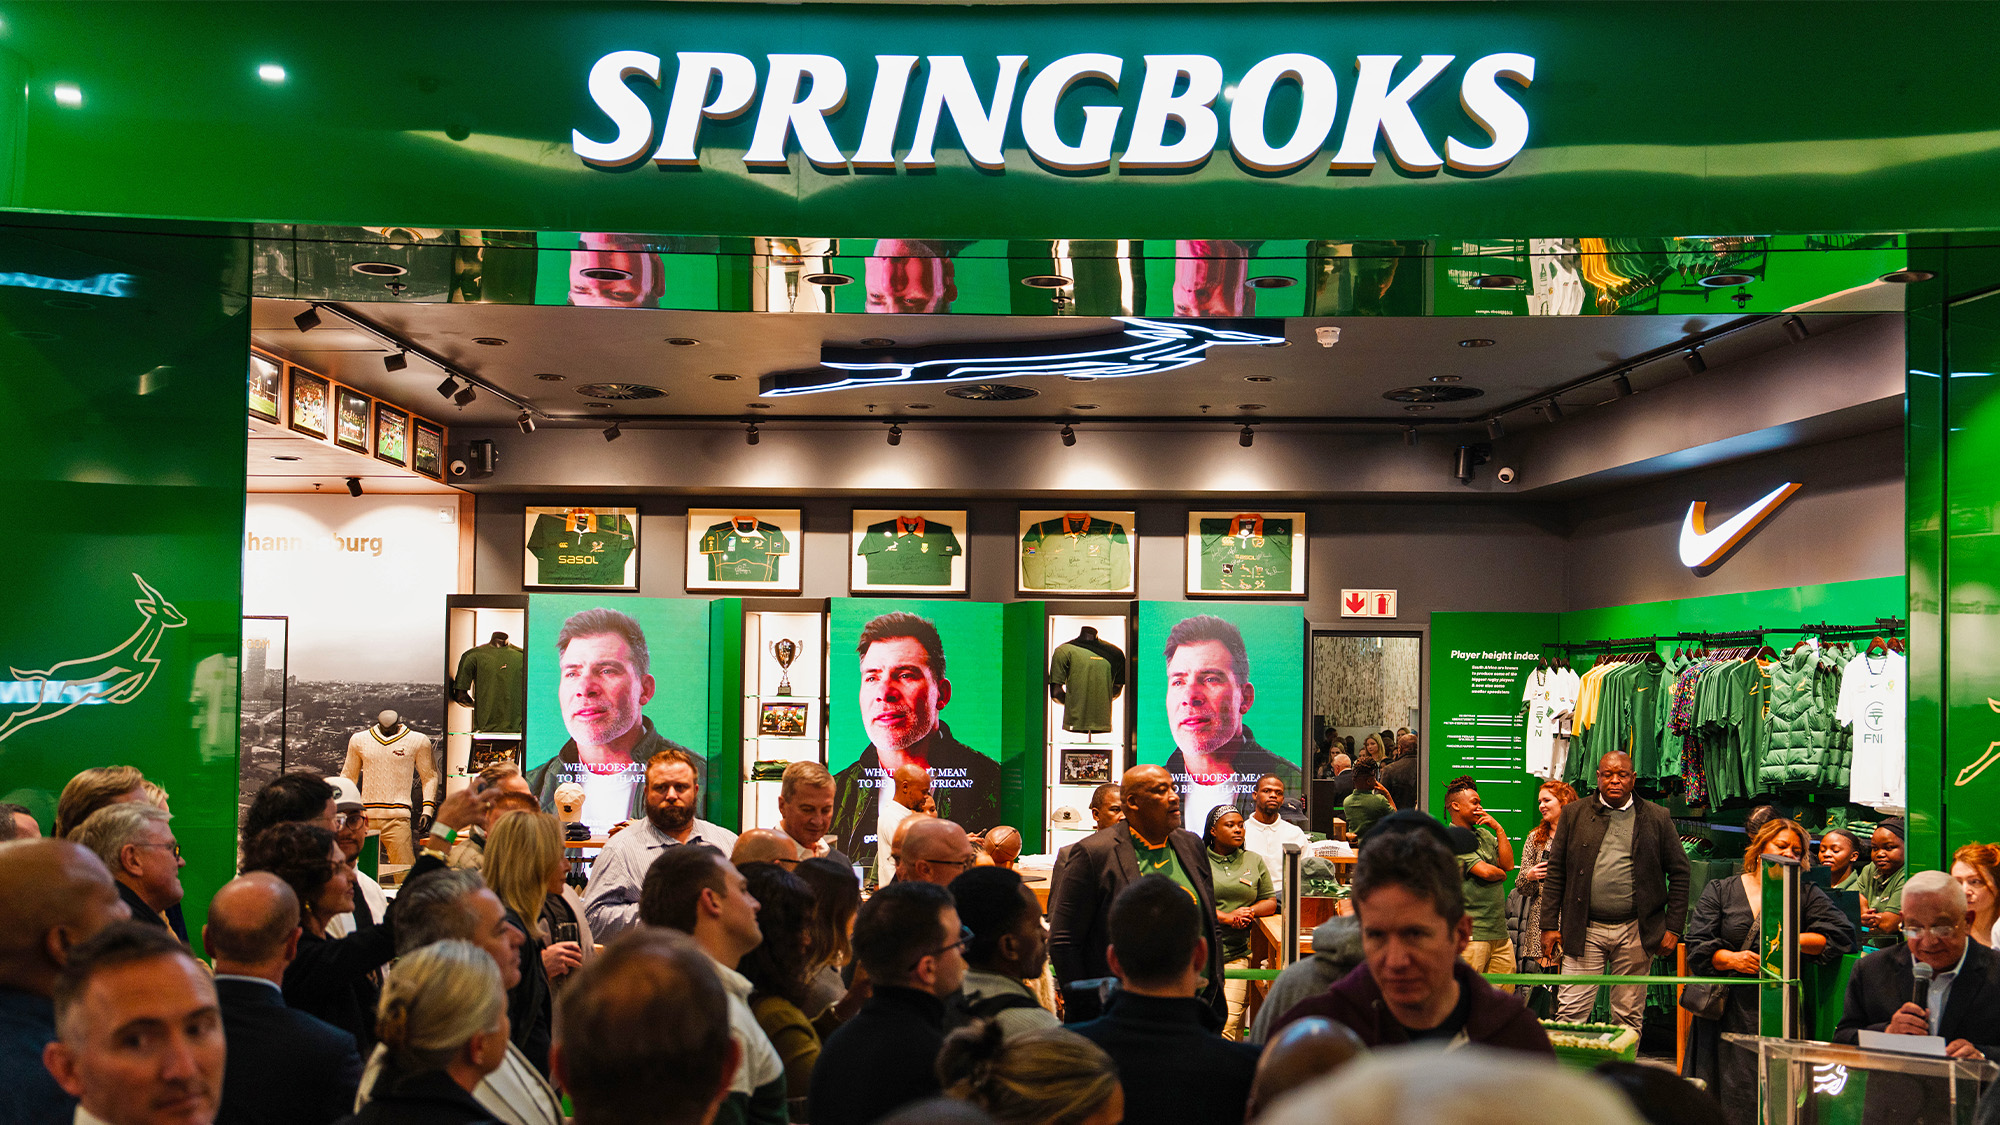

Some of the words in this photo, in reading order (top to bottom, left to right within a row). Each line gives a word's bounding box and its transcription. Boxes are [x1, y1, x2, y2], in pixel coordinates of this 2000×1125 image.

[572, 50, 1536, 169] SPRINGBOKS
[245, 531, 383, 557] hannburg
[1450, 649, 1481, 661] Player
[1481, 650, 1512, 661] height
[1513, 651, 1540, 660] index
[564, 763, 597, 772] WHAT
[597, 763, 626, 772] DOES
[628, 763, 640, 772] IT
[864, 768, 895, 777] WHAT
[926, 768, 937, 777] IT
[938, 768, 967, 777] MEAN
[556, 774, 573, 783] TO
[575, 774, 588, 783] BE
[1171, 773, 1200, 782] WHAT
[1202, 773, 1227, 782] DOES
[1230, 773, 1240, 782] IT
[1241, 773, 1265, 782] MEA
[857, 779, 873, 788] TO
[875, 779, 887, 788] BE
[930, 779, 973, 788] AFRICAN?
[1181, 784, 1192, 793] BE
[1231, 784, 1256, 793] AFRIC
